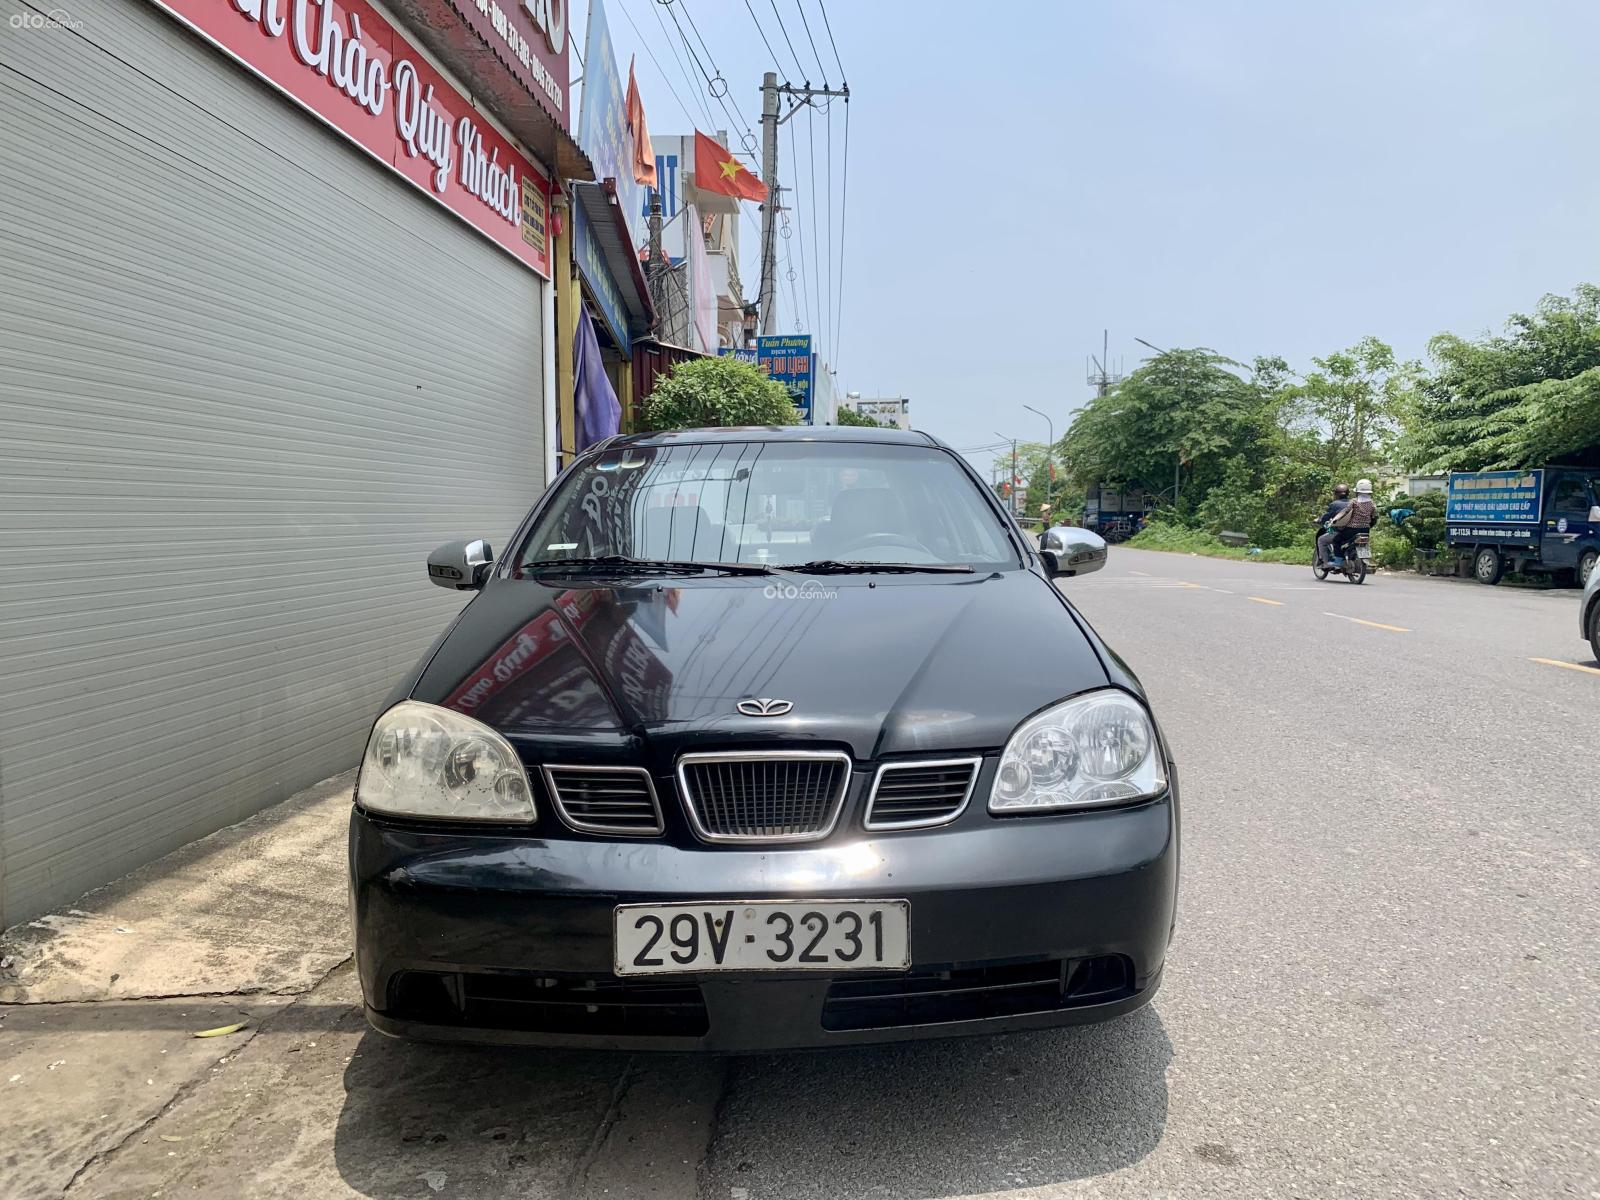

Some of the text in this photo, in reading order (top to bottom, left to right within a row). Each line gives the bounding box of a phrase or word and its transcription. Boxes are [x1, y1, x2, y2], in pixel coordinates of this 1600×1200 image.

[458, 117, 522, 227] Khách
[773, 356, 787, 374] DU
[788, 355, 809, 377] LỊCH
